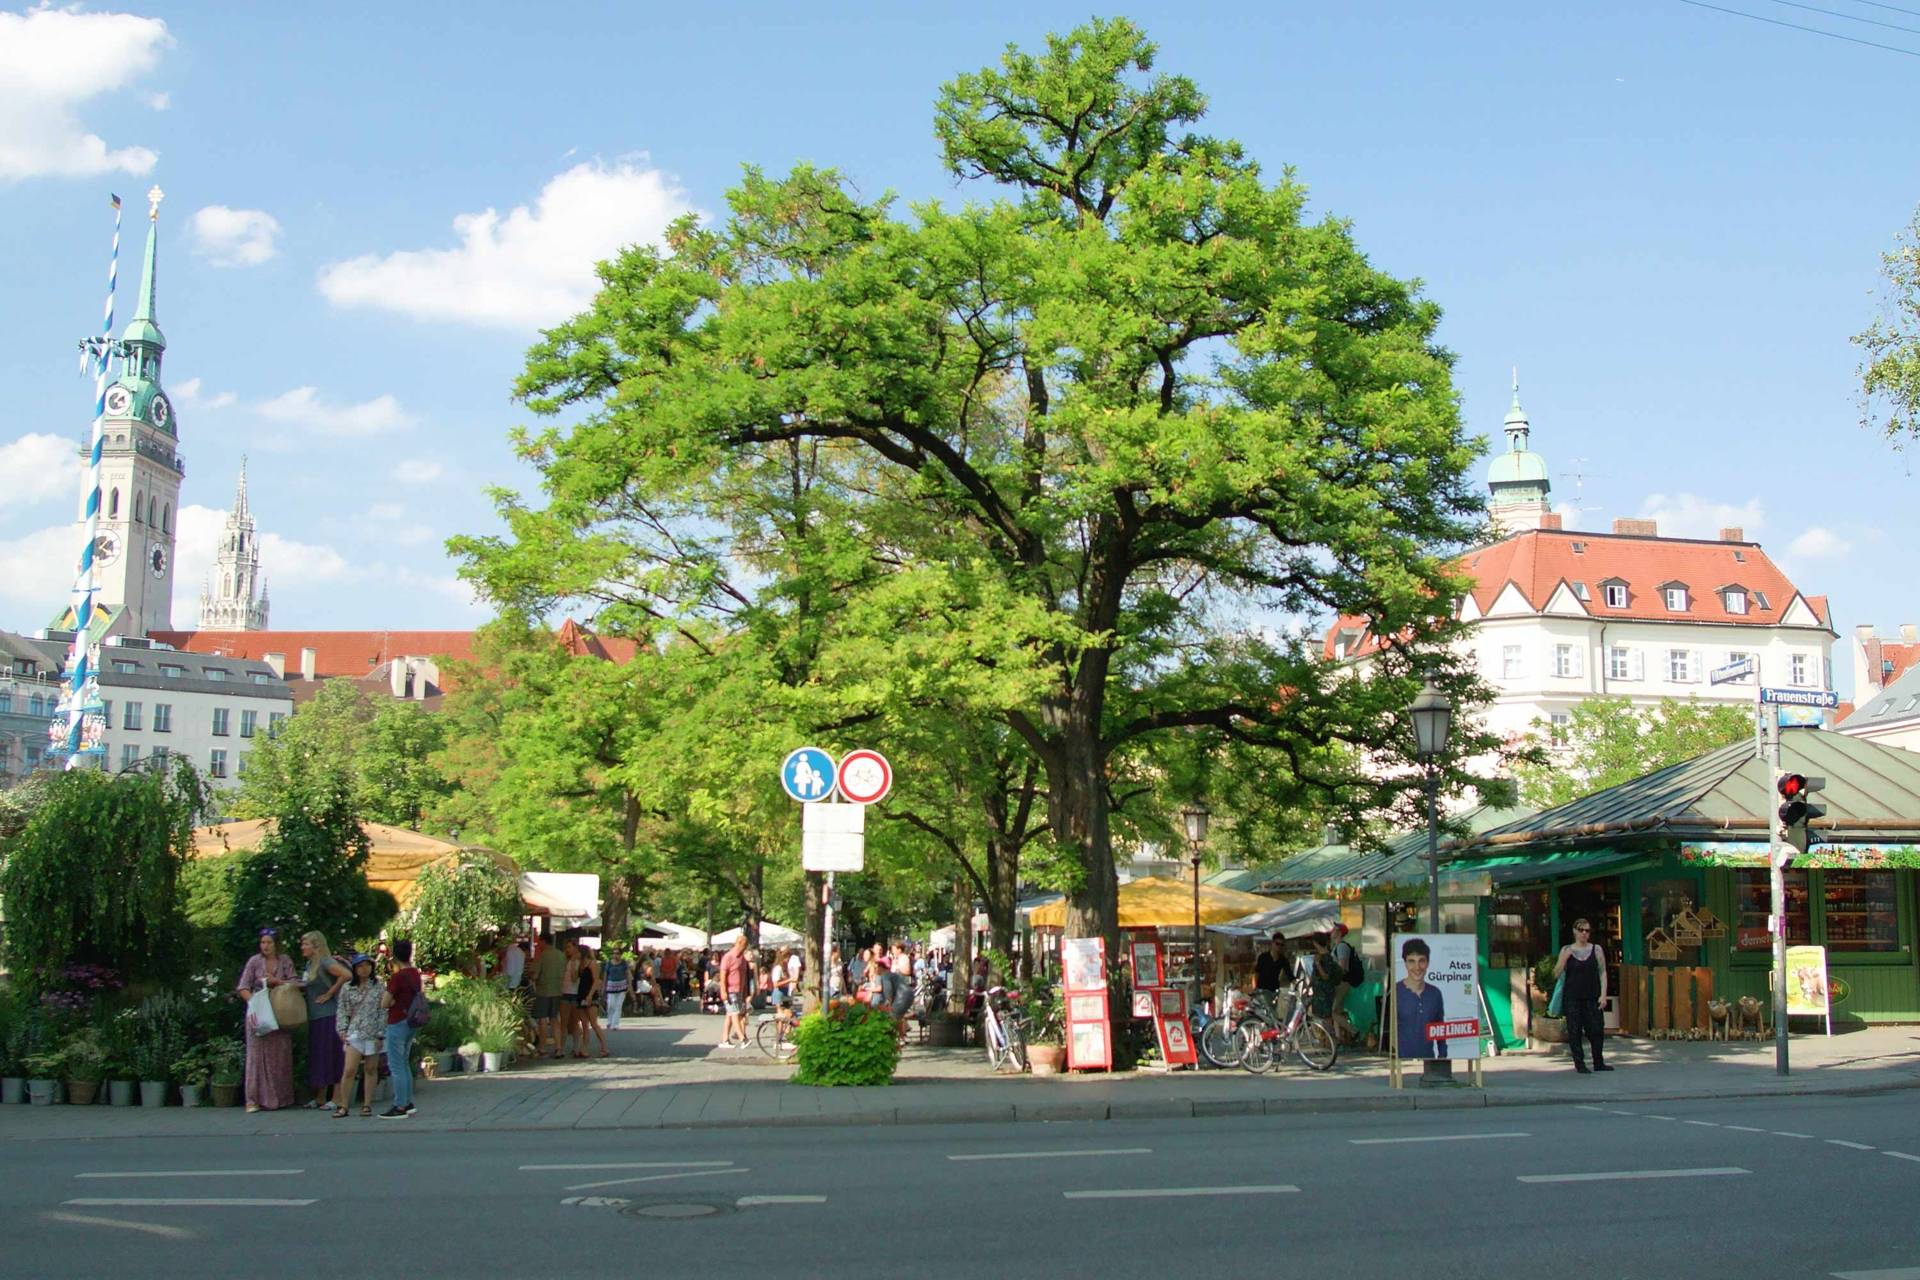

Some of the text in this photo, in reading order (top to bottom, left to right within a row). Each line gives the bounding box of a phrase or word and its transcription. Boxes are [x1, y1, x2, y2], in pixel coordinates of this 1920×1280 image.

[1766, 689, 1834, 705] Frauenstraße
[1449, 960, 1472, 970] Ates
[1428, 971, 1472, 983] Gürpinar
[1429, 1025, 1445, 1038] DIE
